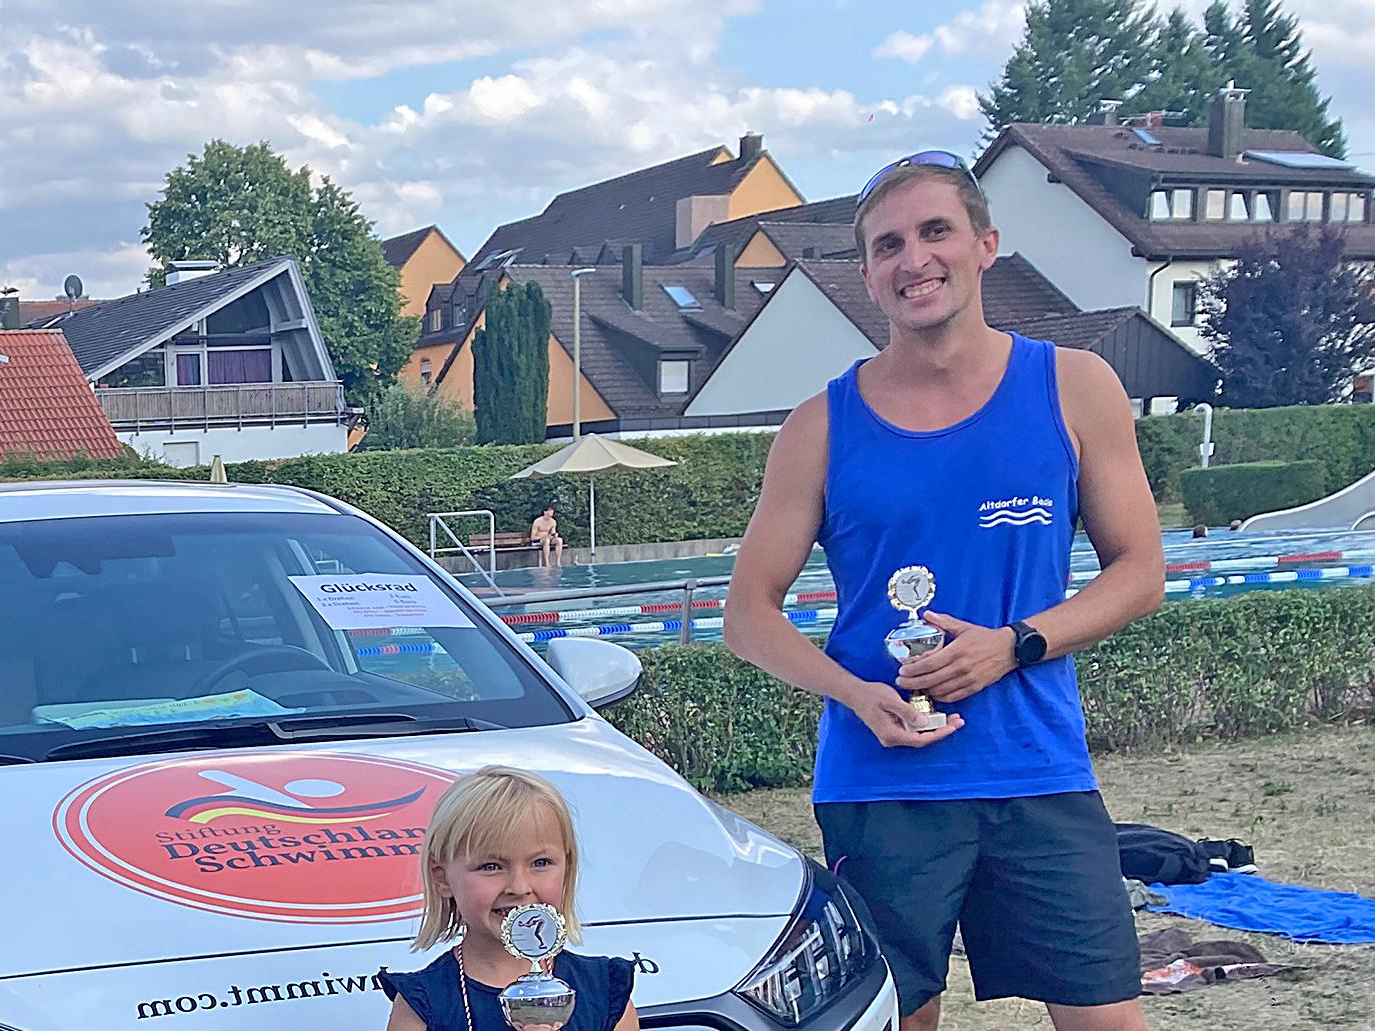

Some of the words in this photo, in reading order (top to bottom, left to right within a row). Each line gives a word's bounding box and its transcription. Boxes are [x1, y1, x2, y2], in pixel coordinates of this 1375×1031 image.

[978, 496, 1029, 512] Altdorfer
[320, 581, 418, 595] Glücksrad
[155, 824, 281, 843] Stiftung
[162, 826, 427, 860] Deutschlan
[194, 843, 423, 873] Schwimm
